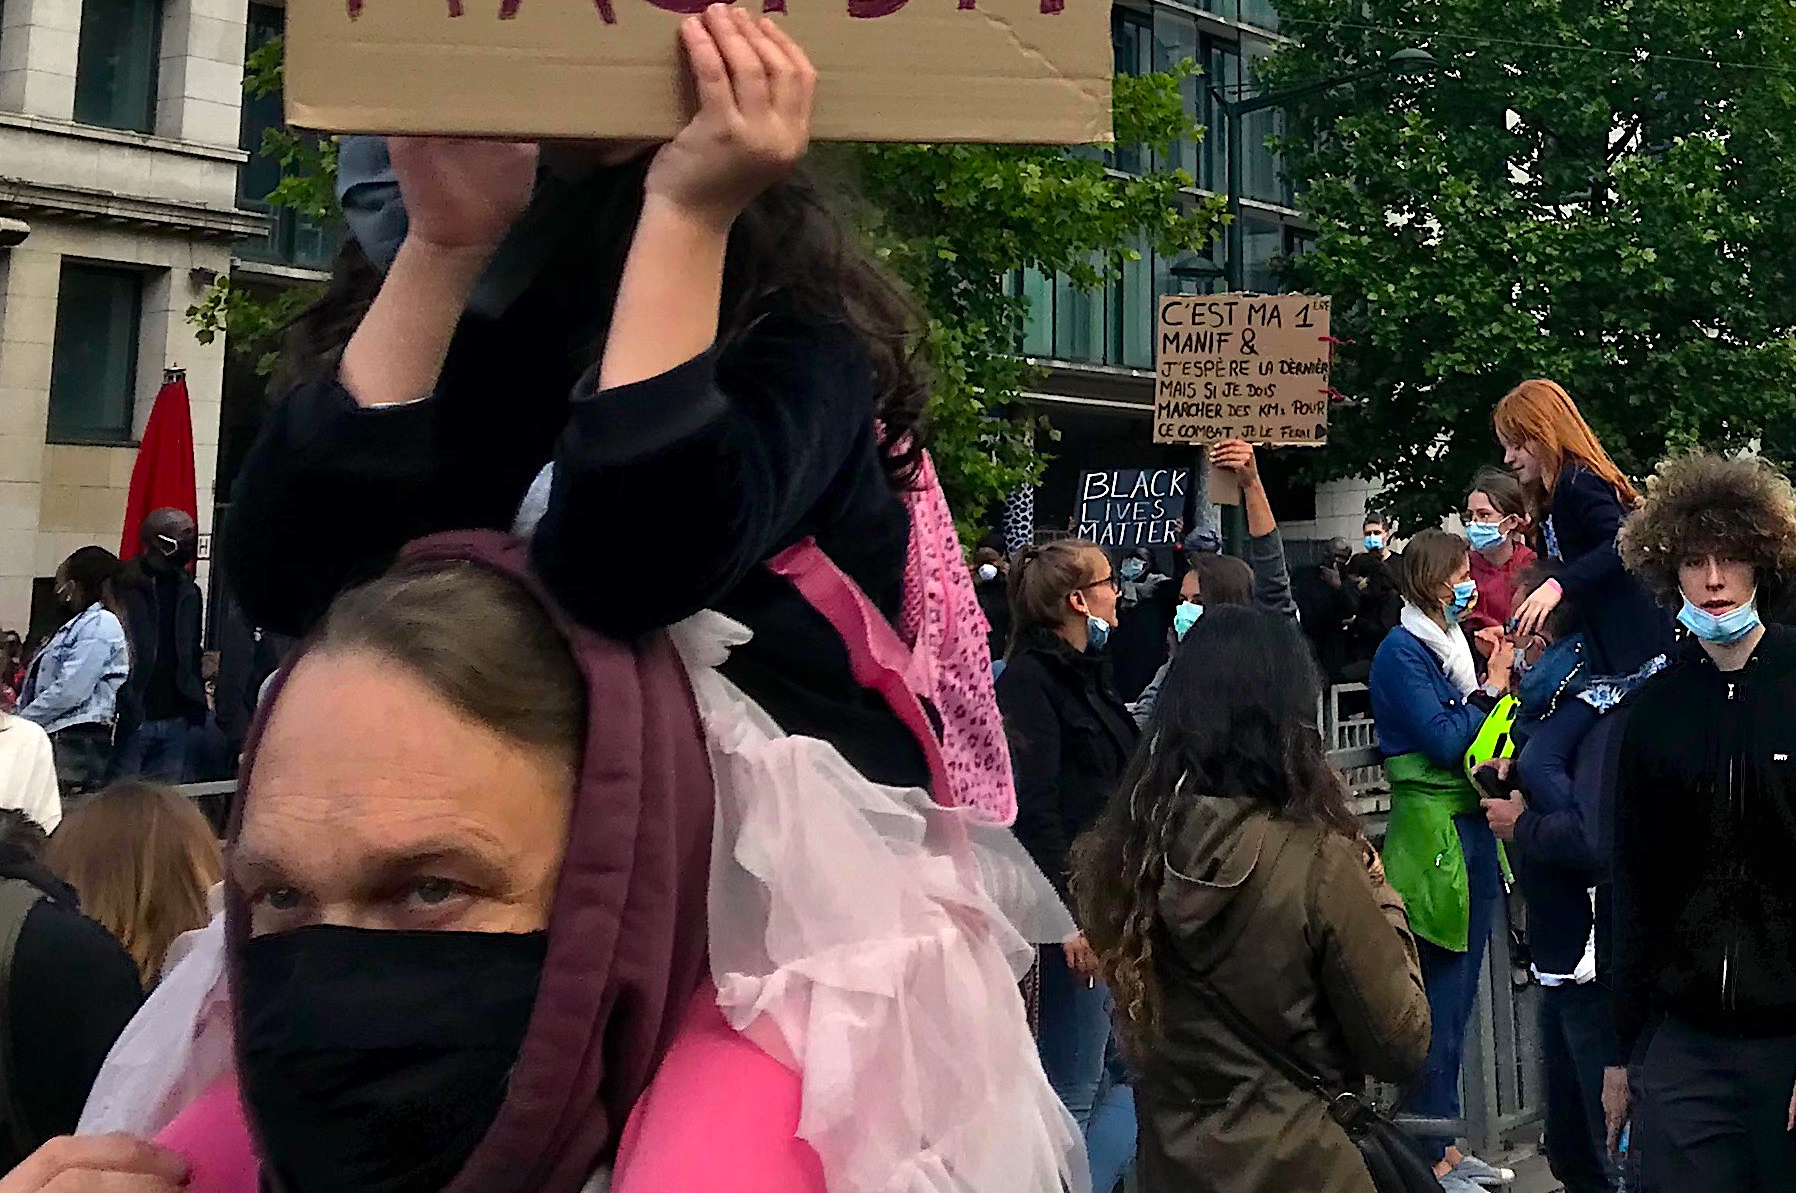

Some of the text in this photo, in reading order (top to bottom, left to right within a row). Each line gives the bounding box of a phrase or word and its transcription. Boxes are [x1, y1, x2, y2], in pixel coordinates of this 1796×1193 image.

[1162, 301, 1238, 328] C'EST
[1248, 303, 1282, 328] MA
[1163, 328, 1258, 355] MANIF &
[1161, 357, 1250, 377] J'ESPÈRE
[1259, 360, 1273, 375] LA
[1160, 381, 1277, 399] MAIS SI JE DOIS
[1158, 400, 1223, 419] MARCHER
[1228, 405, 1250, 417] DES
[1291, 400, 1325, 415] POUR
[1158, 423, 1174, 438] CE
[1260, 424, 1273, 438] LE
[1083, 469, 1187, 501] BLACK
[1077, 519, 1177, 545] MATTER
